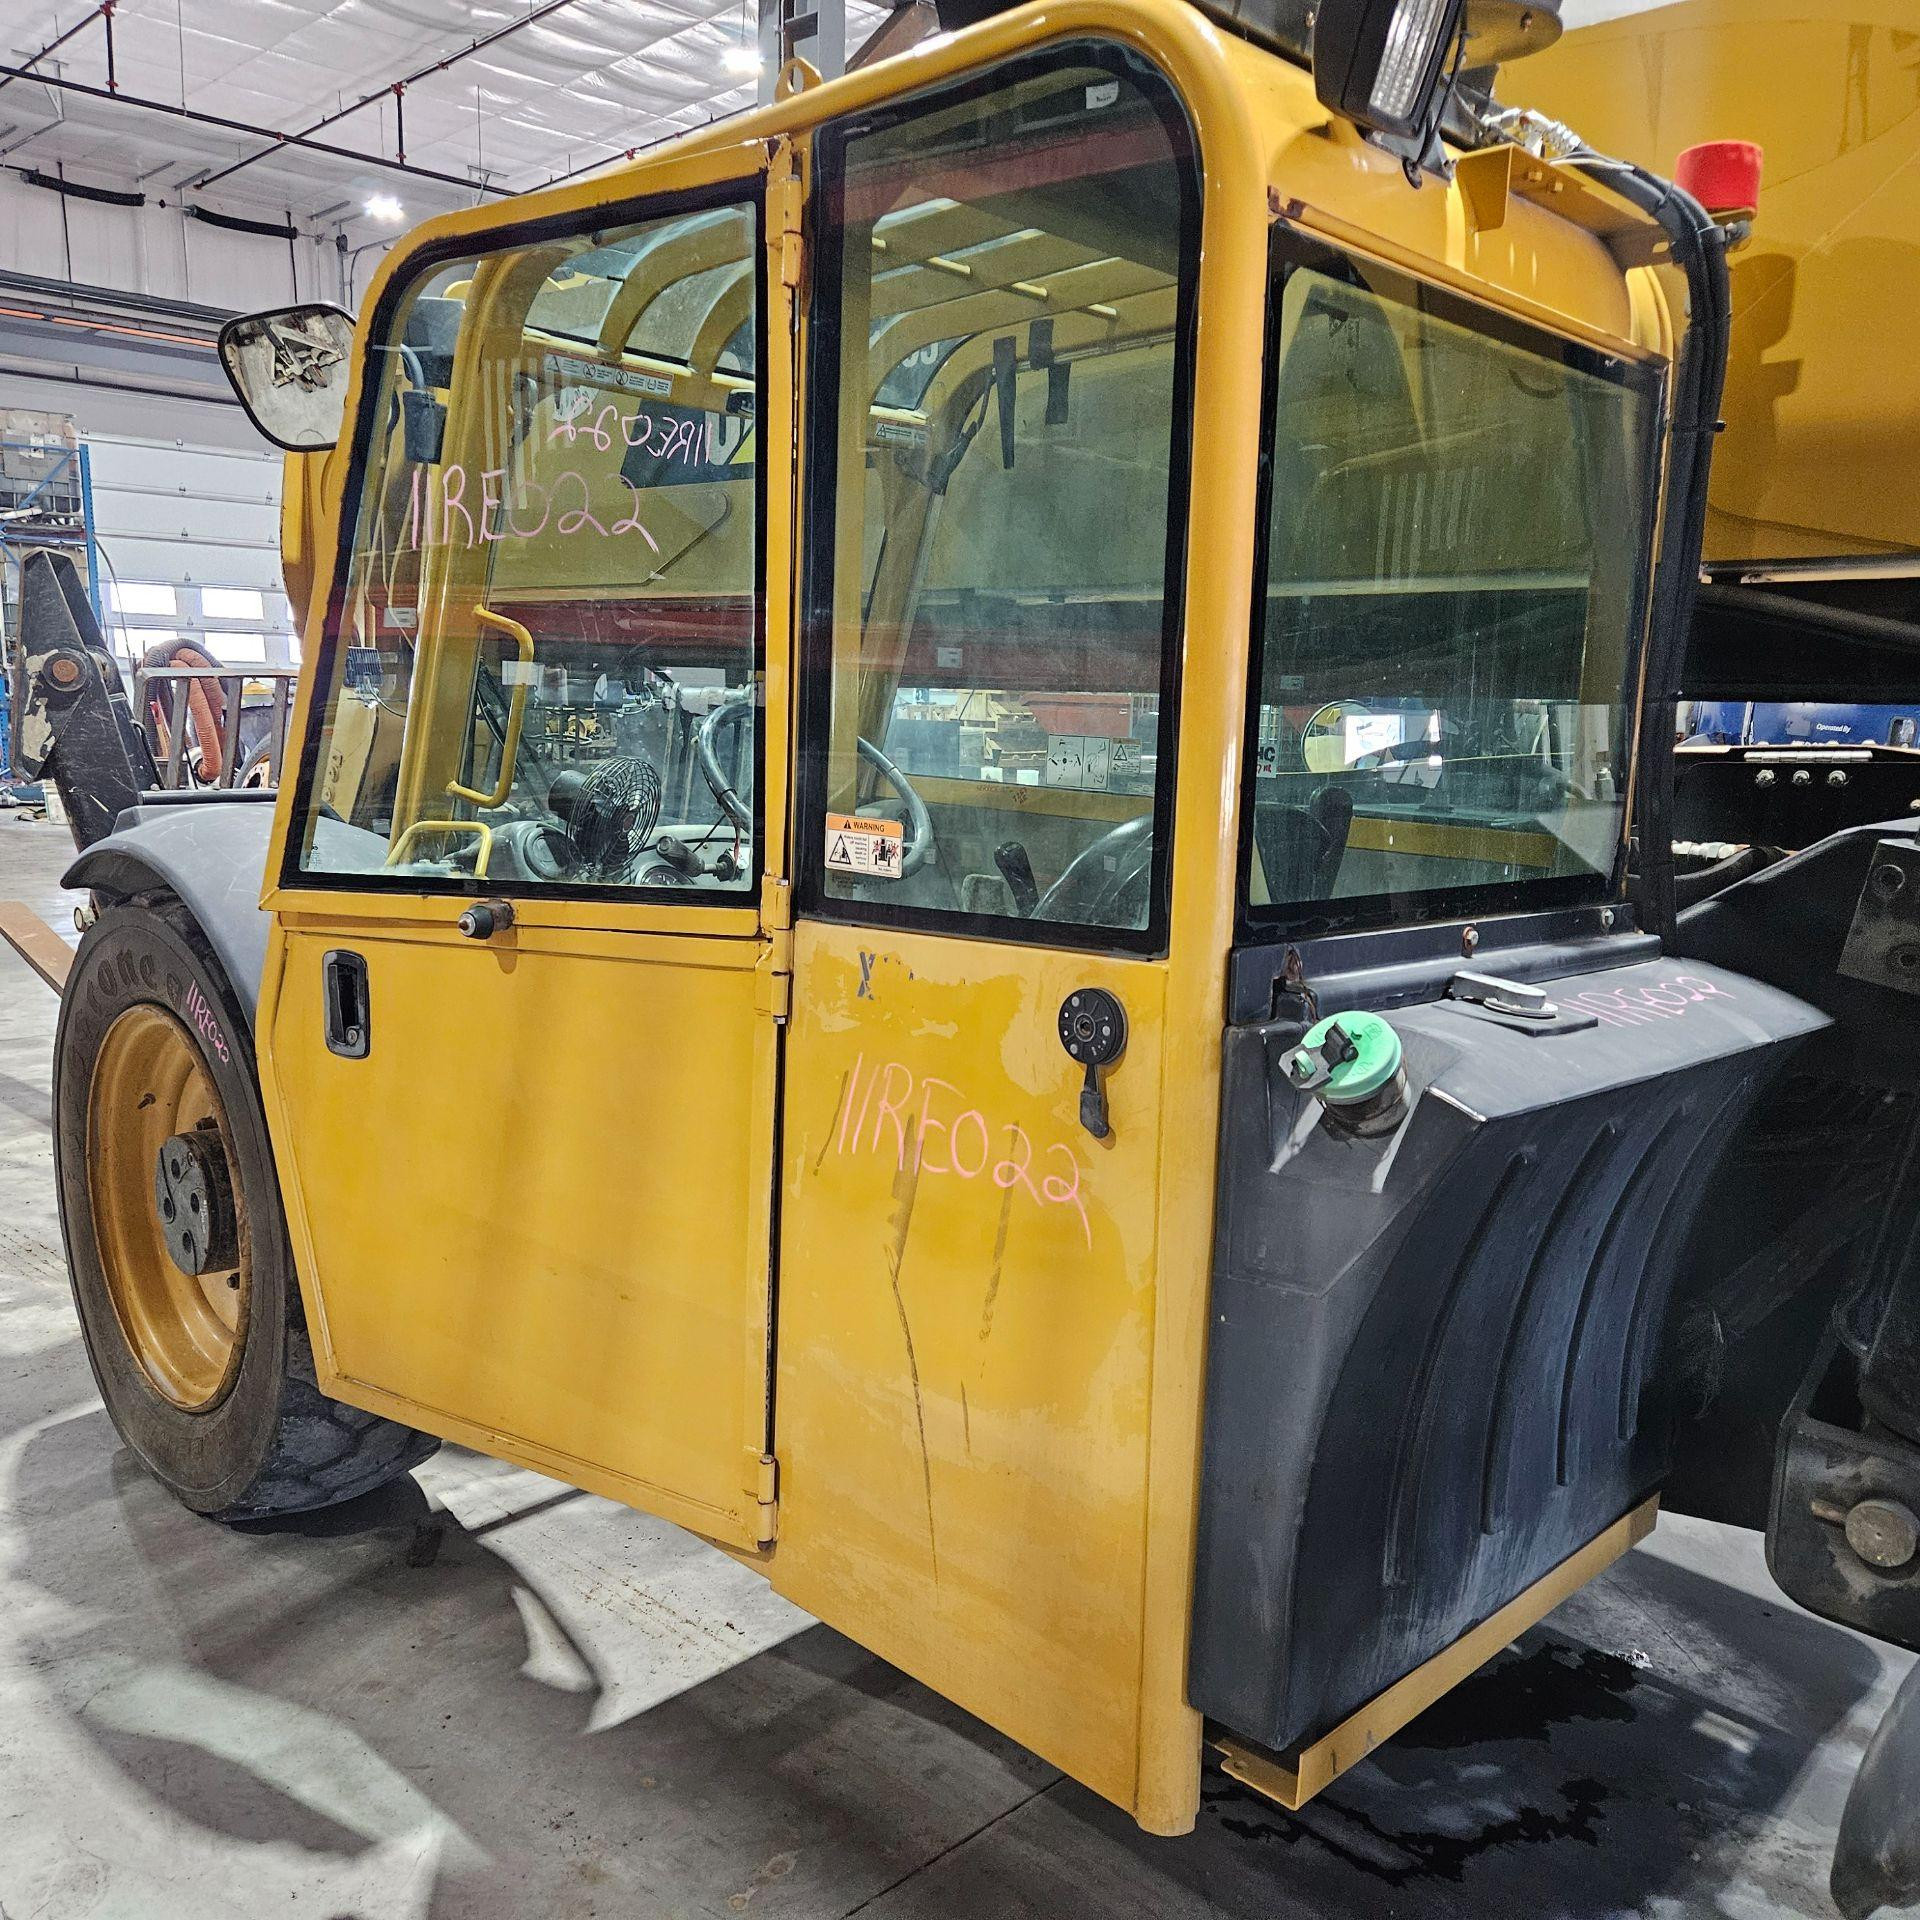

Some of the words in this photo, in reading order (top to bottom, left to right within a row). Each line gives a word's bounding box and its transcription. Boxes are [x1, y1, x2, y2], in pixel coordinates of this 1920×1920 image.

[411, 464, 660, 555] 11RE022
[1816, 723, 1843, 732] Operated
[1843, 725, 1851, 734] By
[853, 821, 885, 833] WARNING
[838, 1051, 1093, 1252] 11RE022
